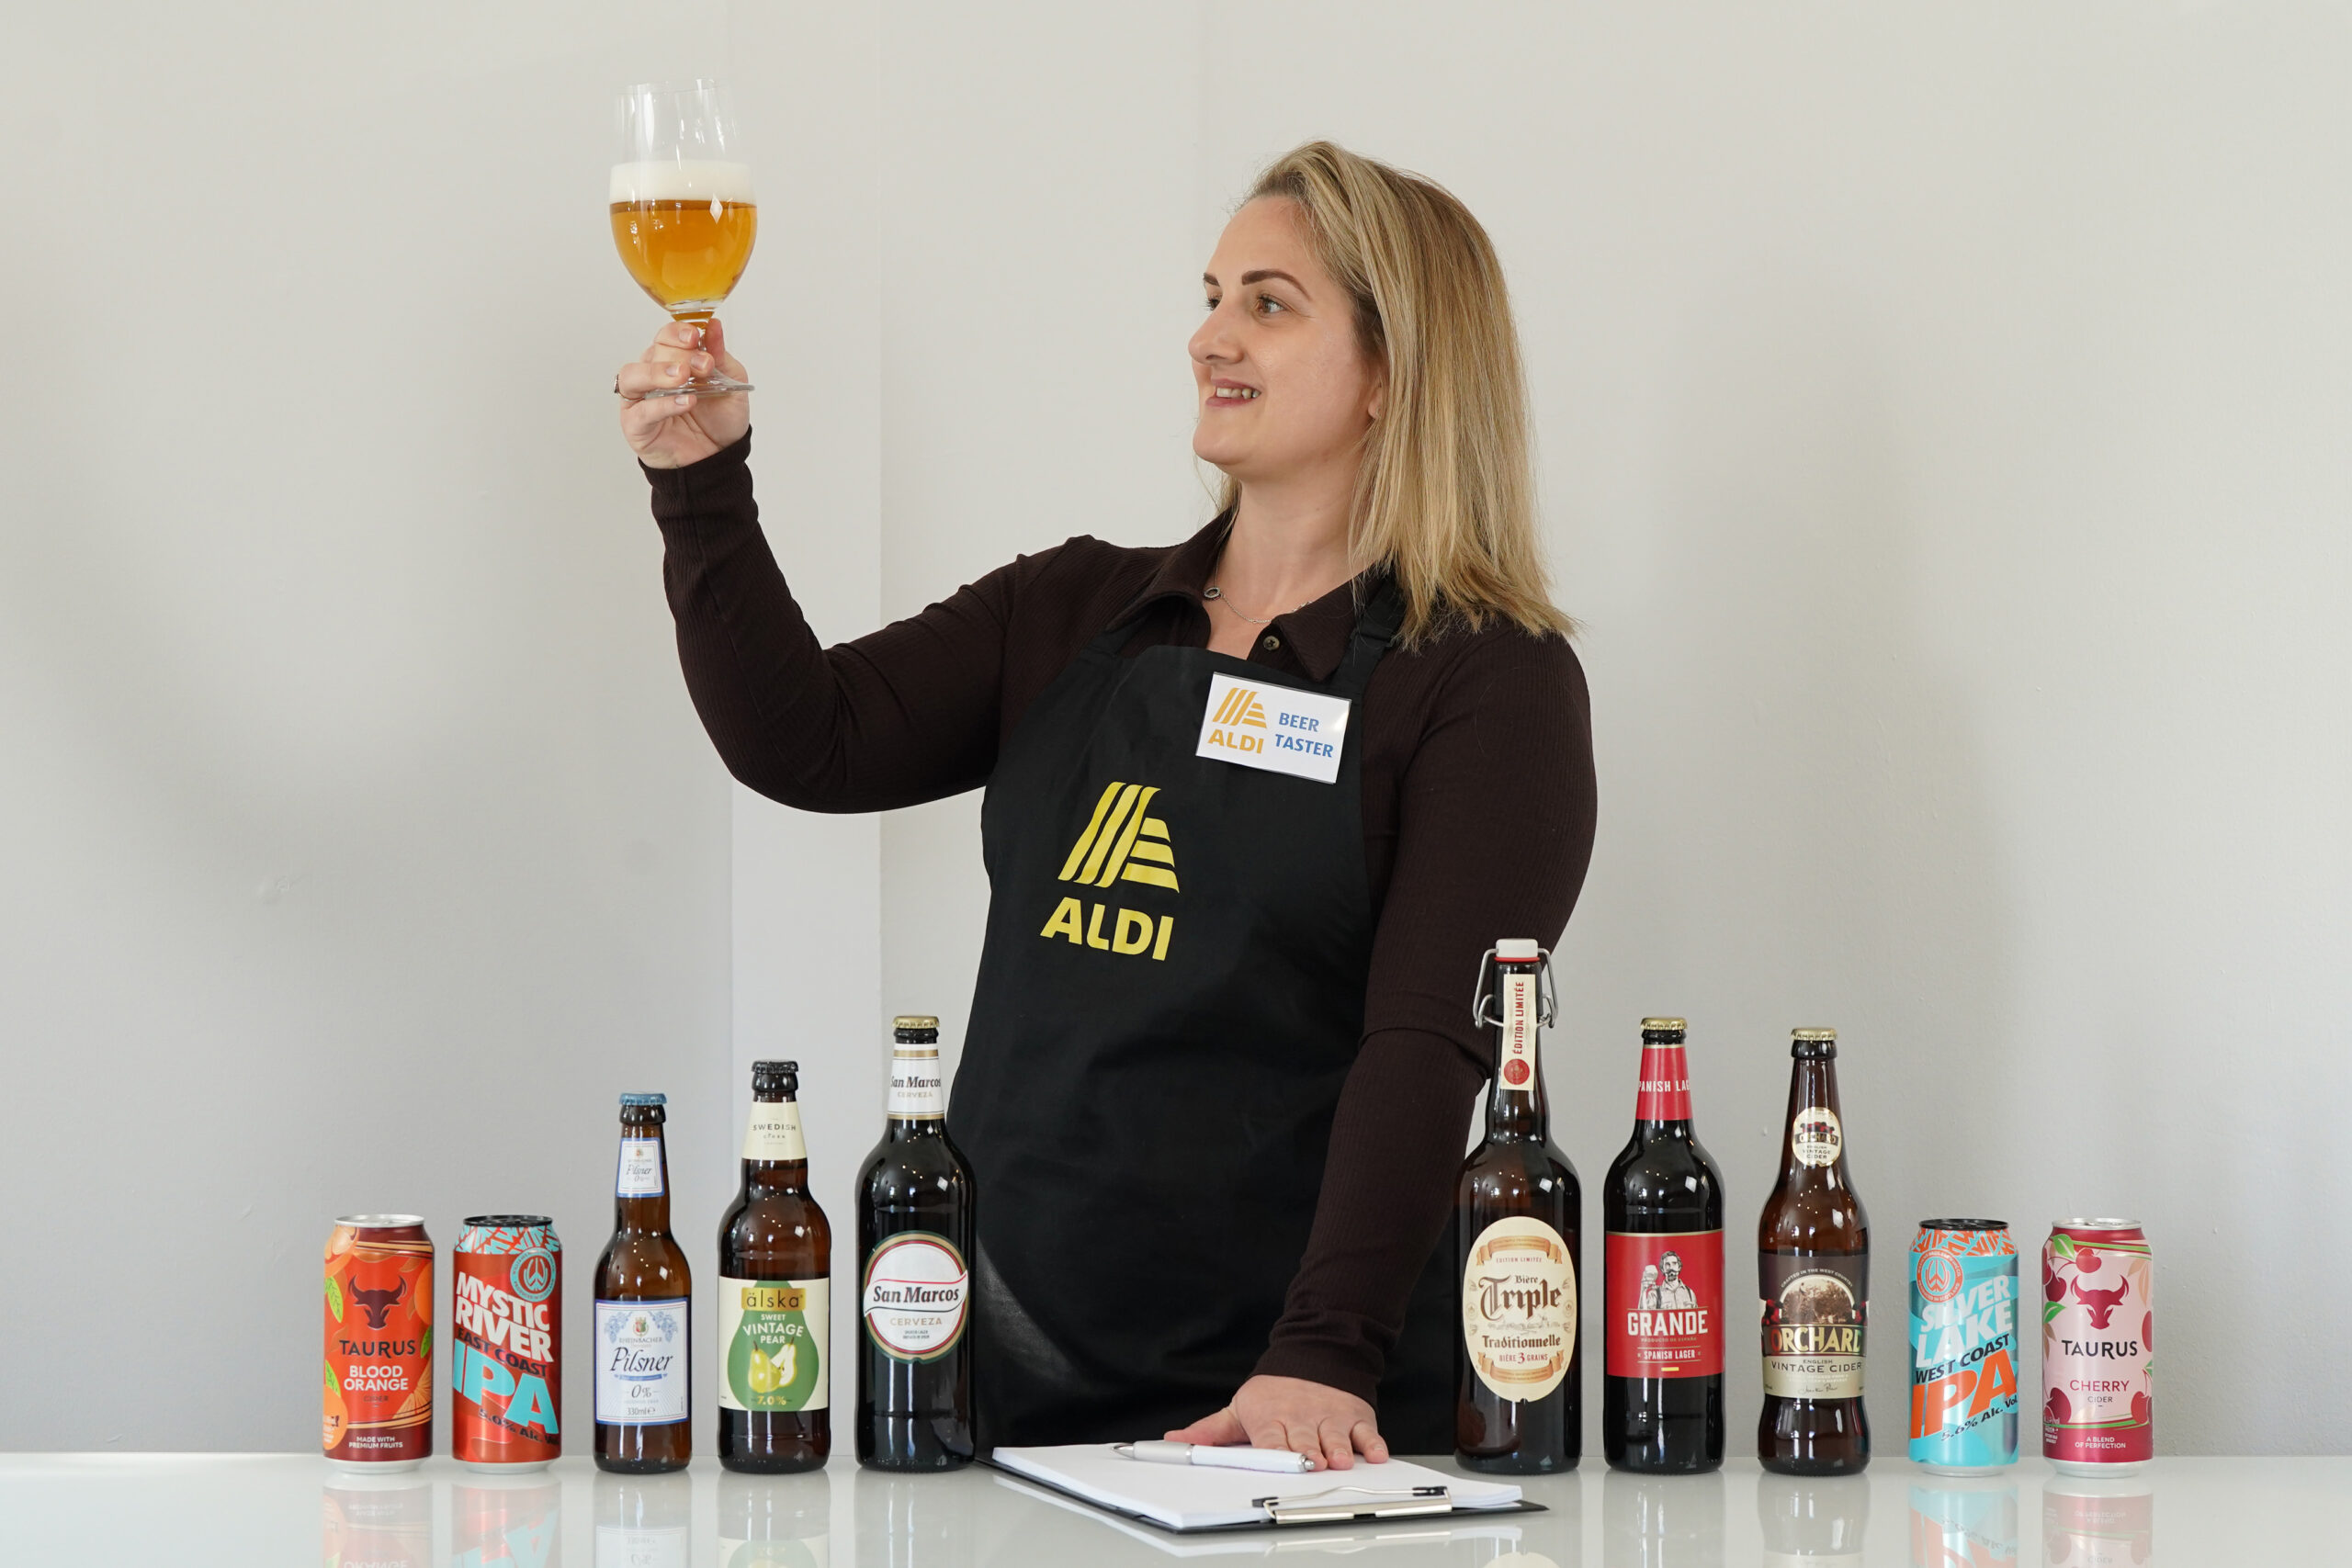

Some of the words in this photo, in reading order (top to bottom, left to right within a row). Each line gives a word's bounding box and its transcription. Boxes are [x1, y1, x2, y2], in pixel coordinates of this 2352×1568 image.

[1279, 712, 1319, 732] BEER
[1208, 728, 1264, 754] ALDI
[1275, 733, 1334, 758] TASTER
[1040, 897, 1174, 961] ALDI
[1514, 982, 1524, 1017] LIMITÉE
[1513, 1020, 1524, 1055] ÉDITION
[1516, 1274, 1539, 1284] Bière
[456, 1271, 550, 1332] MYSTIC
[747, 1290, 799, 1308] älska
[873, 1286, 901, 1303] San
[903, 1286, 959, 1303] Marcos
[1478, 1274, 1562, 1322] Triple
[1920, 1274, 2010, 1333] SILVER
[456, 1296, 554, 1362] RIVER
[742, 1322, 804, 1337] VINTAGE
[890, 1317, 943, 1327] CERVEZA
[1627, 1310, 1709, 1337] GRANDE
[760, 1336, 786, 1344] PEAR
[1482, 1334, 1561, 1348] Traditionnelle
[1770, 1326, 1862, 1352] ORCHARD
[1916, 1300, 2013, 1368] LAKE
[339, 1339, 416, 1359] TAURUS
[458, 1328, 492, 1355] EAST
[494, 1348, 548, 1377] COAST
[1499, 1352, 1517, 1362] BIÈRE
[1517, 1352, 1525, 1365] 3
[1527, 1353, 1548, 1362] GRAINS
[1644, 1350, 1673, 1360] SPANISH
[1675, 1349, 1695, 1359] LAGER
[1916, 1359, 1956, 1384] WEST
[1960, 1334, 2010, 1368] COAST
[2061, 1339, 2138, 1359] TAURUS
[610, 1347, 674, 1372] Pilsner
[1771, 1360, 1825, 1373] VINTAGE
[1829, 1361, 1862, 1372] CIDER
[349, 1365, 403, 1379] BLOOD
[344, 1379, 409, 1392] ORANGE
[452, 1338, 560, 1434] IPA
[1910, 1348, 2018, 1439] IPA
[2070, 1380, 2130, 1393] CHERRY
[363, 1395, 389, 1404] CIDER
[757, 1395, 786, 1405] 7.0%
[2087, 1395, 2113, 1404] CIDER
[478, 1408, 516, 1433] 5.0%
[519, 1427, 543, 1444] Alc.
[1940, 1418, 1978, 1442] 5.6%
[1981, 1406, 2004, 1424] Alc.
[348, 1441, 379, 1450] PREMIUM
